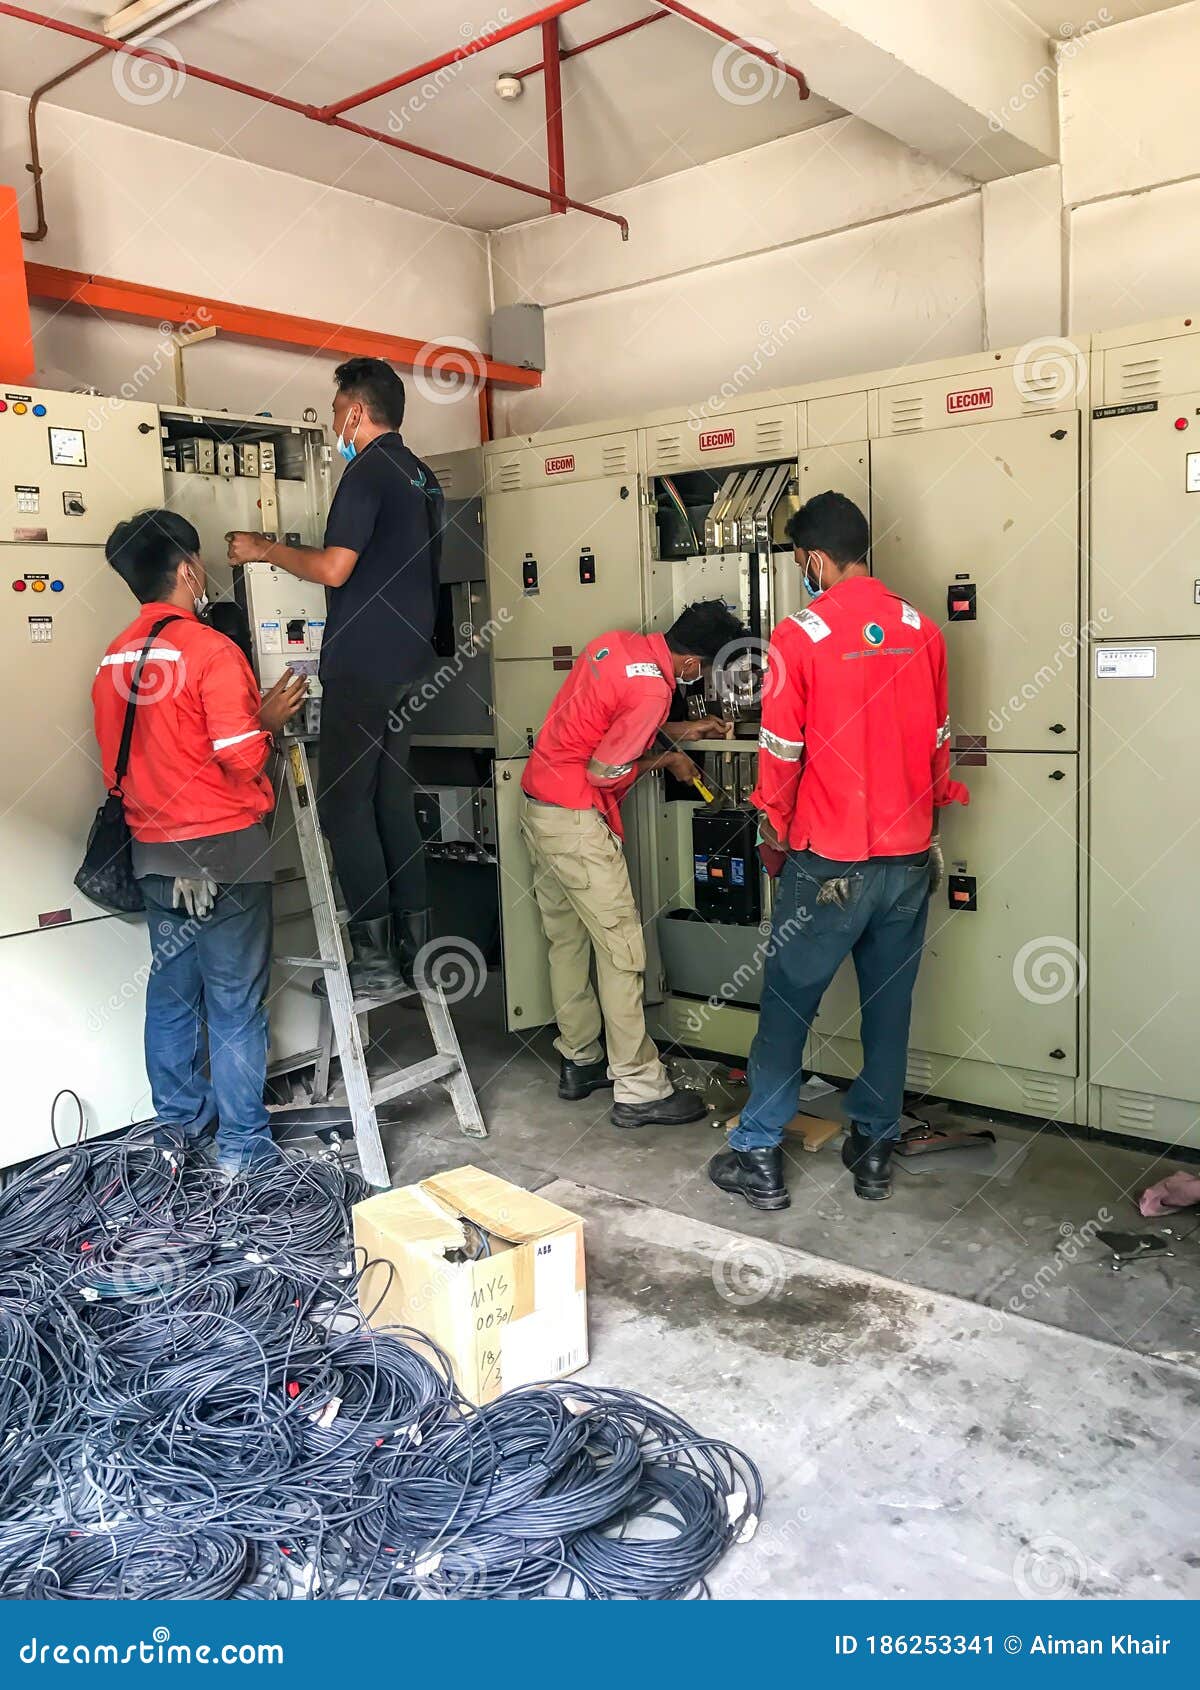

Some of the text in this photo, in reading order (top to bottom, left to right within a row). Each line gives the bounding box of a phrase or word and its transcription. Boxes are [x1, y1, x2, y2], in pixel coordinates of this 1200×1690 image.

[950, 391, 990, 409] LECOM
[701, 432, 733, 447] LECOM
[547, 458, 573, 472] LECOM
[537, 1245, 552, 1256] ABB
